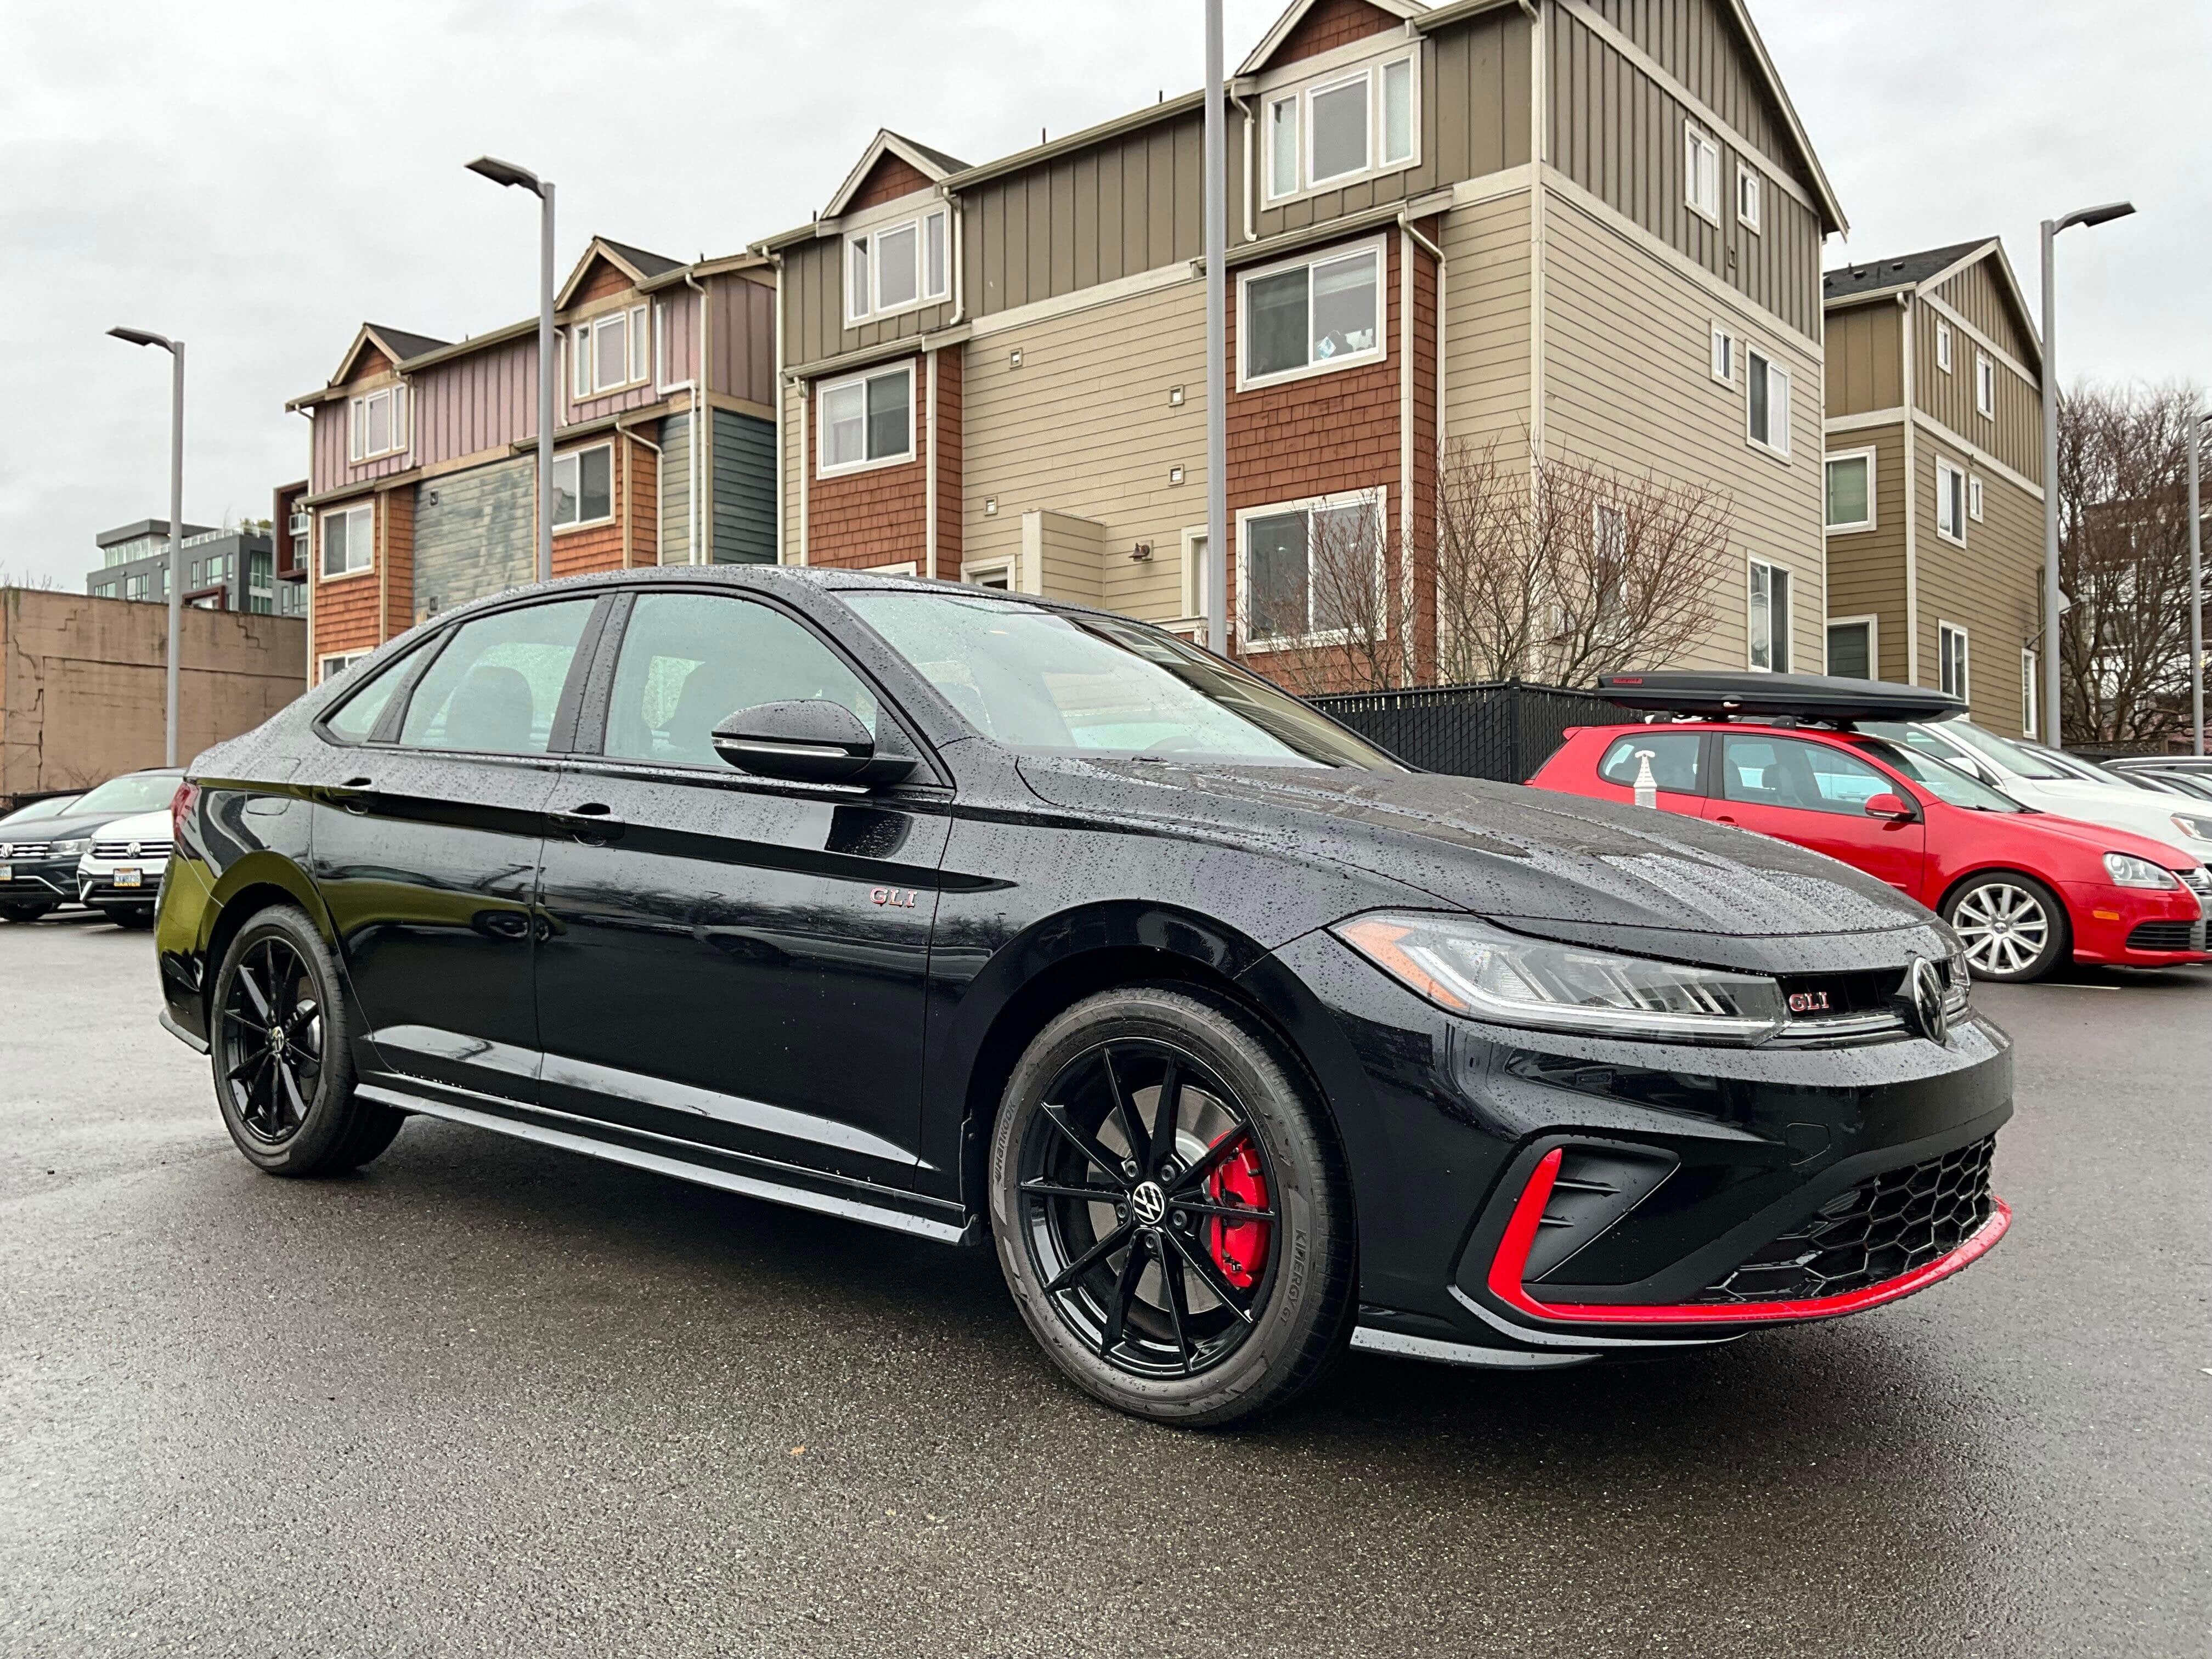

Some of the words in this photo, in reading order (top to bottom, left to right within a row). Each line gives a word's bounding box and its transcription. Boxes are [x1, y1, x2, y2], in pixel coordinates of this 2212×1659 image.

[870, 887, 918, 908] GLI
[1789, 991, 1829, 1012] GLI
[1133, 1181, 1165, 1224] VW
[1289, 1228, 1306, 1308] KINERGY
